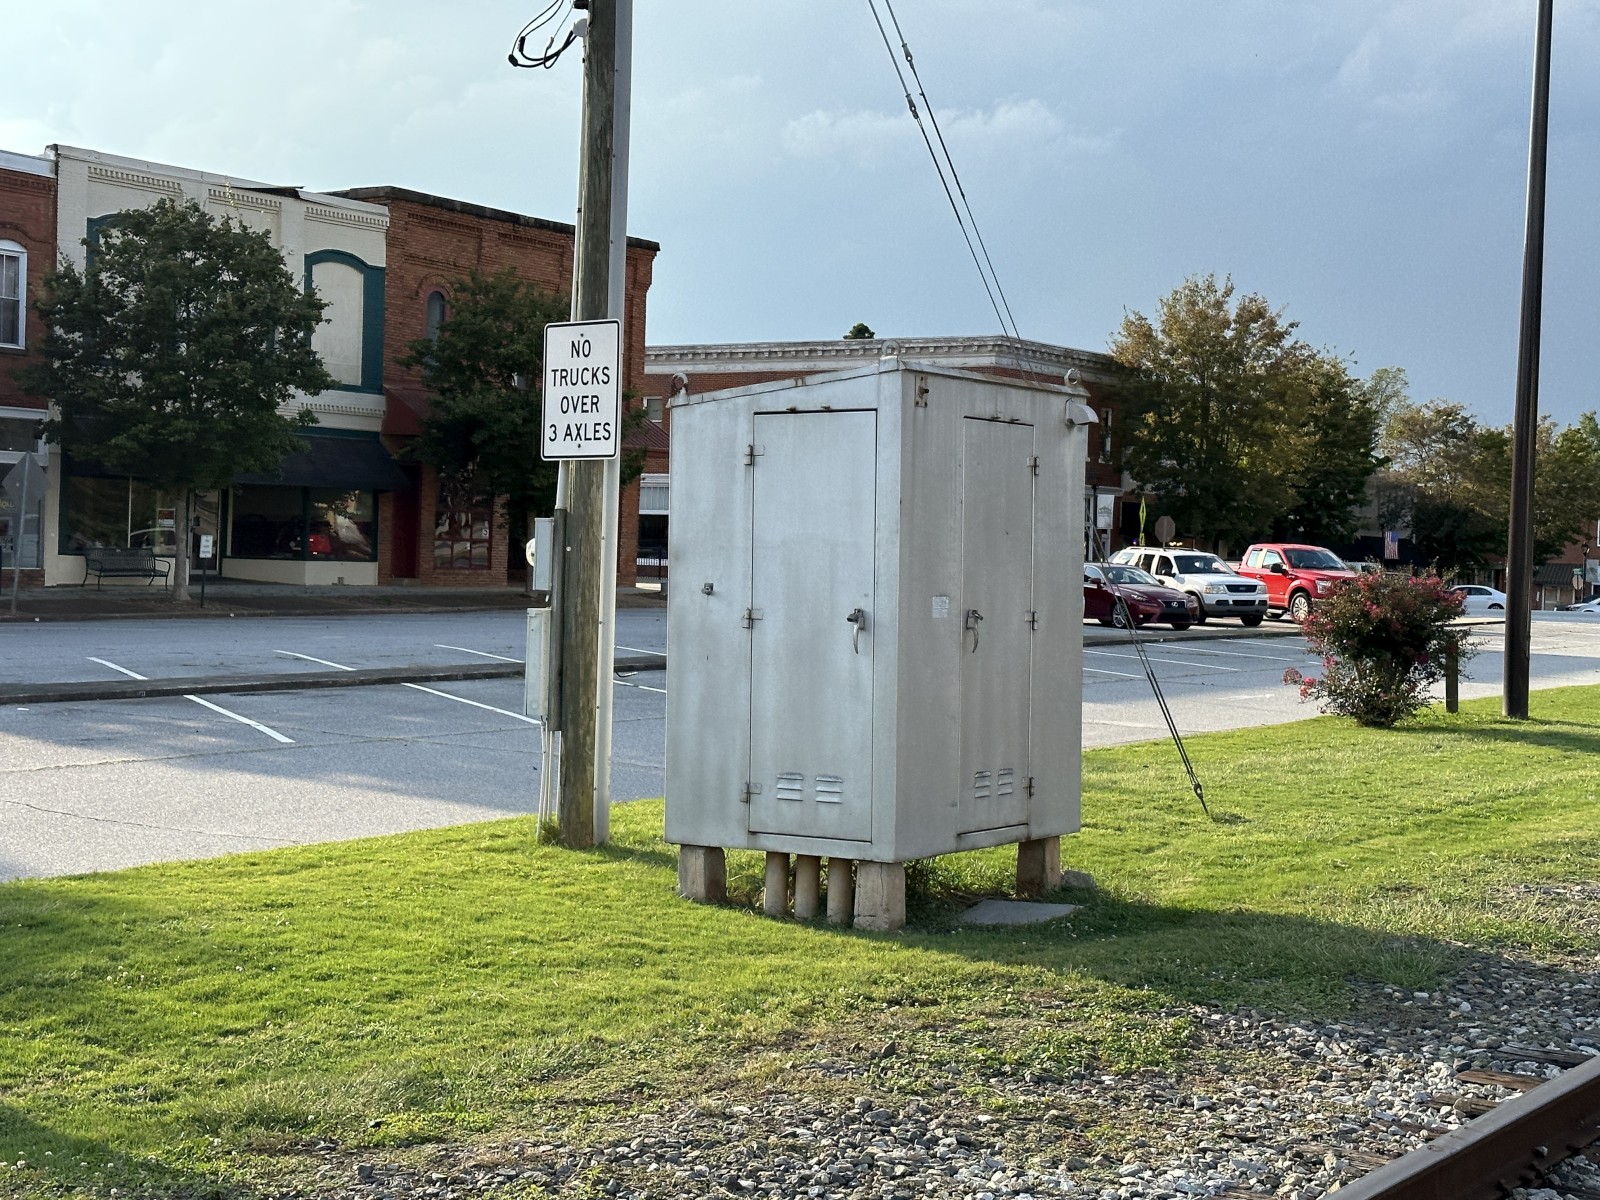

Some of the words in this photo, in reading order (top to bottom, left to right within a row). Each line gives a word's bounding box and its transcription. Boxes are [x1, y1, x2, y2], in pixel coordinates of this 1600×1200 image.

[571, 339, 591, 358] NO
[551, 366, 610, 387] TRUCKS
[561, 395, 600, 414] OVER
[549, 424, 557, 442] 3
[563, 423, 611, 441] AXLES
